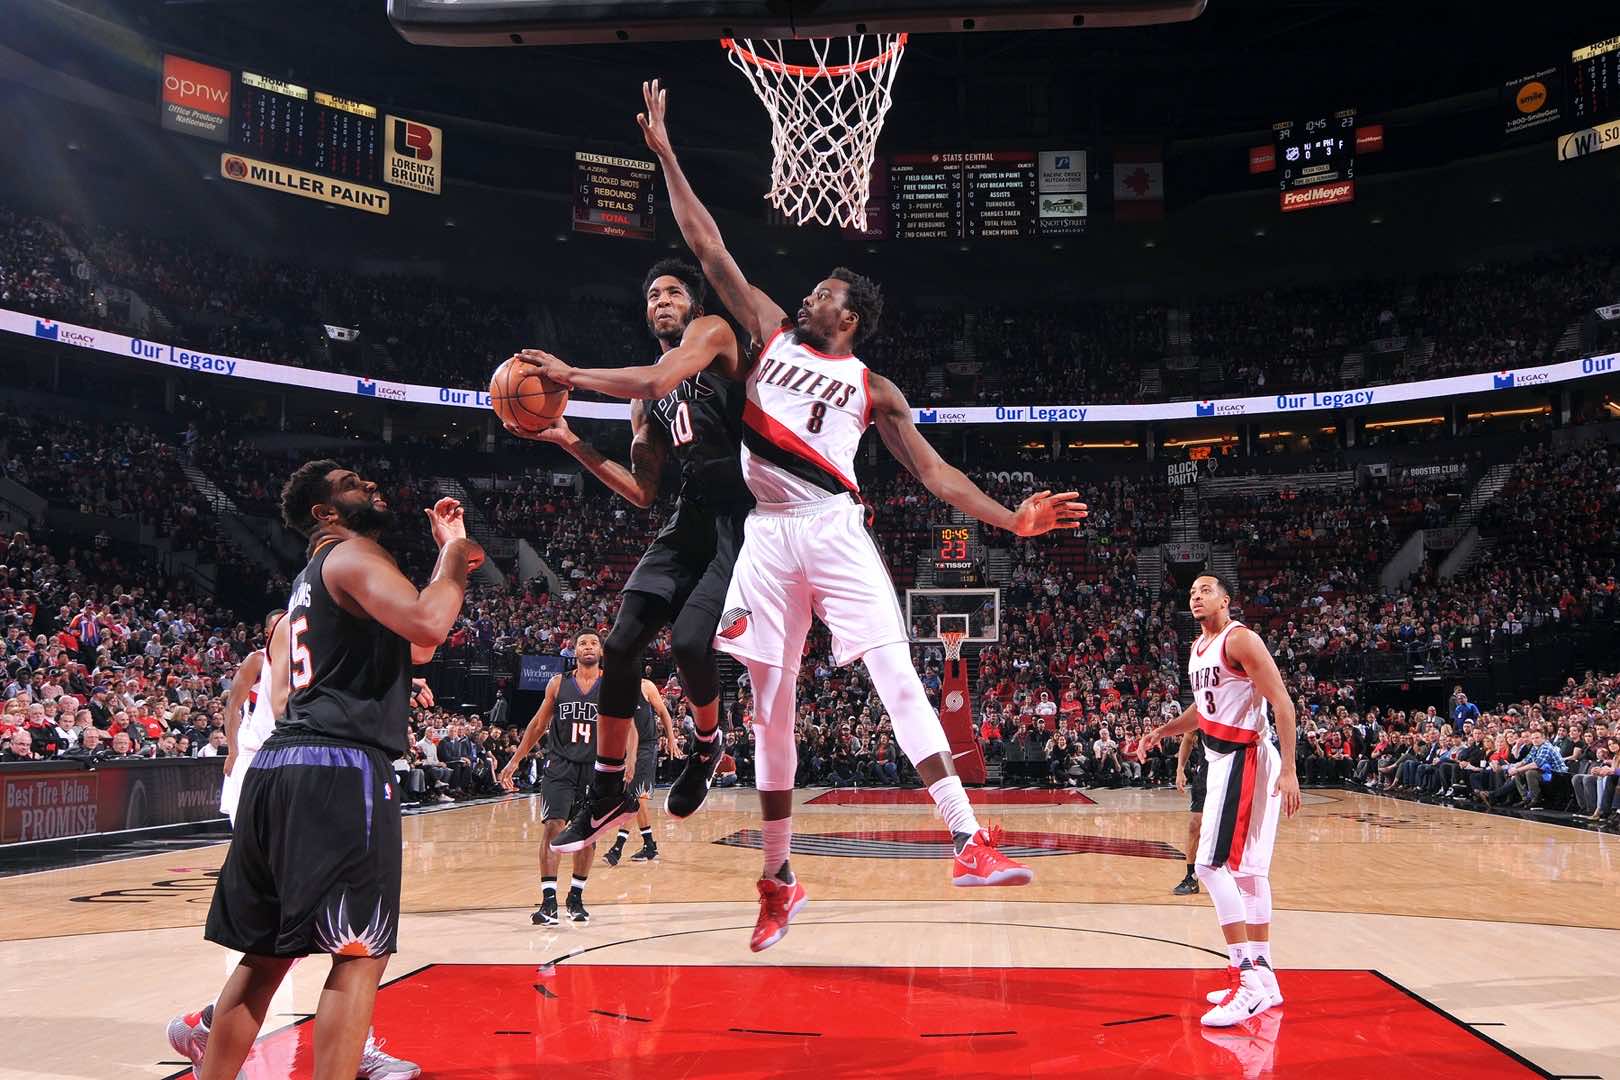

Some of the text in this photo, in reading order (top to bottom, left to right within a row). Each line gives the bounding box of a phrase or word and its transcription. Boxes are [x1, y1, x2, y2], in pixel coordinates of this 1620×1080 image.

[1590, 37, 1617, 51] HOME
[165, 75, 229, 103] opnw
[261, 75, 289, 89] HOME
[168, 104, 224, 125] Office Products
[175, 114, 216, 131] Nationwide
[1342, 117, 1353, 127] 23
[1280, 130, 1290, 140] 39
[1323, 138, 1334, 147] PHI
[1339, 140, 1343, 150] F
[1326, 147, 1331, 155] 3
[391, 157, 435, 174] LORENTZ
[580, 153, 650, 169] HUSTLEBOARD
[965, 153, 994, 161] CENTRAL
[391, 167, 435, 187] BRUUN
[591, 175, 619, 186] BLOCKED
[620, 180, 639, 188] SHOTS
[250, 165, 387, 209] MILLER PAINT
[580, 184, 589, 193] 15
[594, 187, 636, 200] REBOUNDS
[597, 200, 634, 211] STEALS
[648, 206, 653, 214] 3
[601, 212, 631, 224] TOTAL
[61, 330, 236, 376] LEGACY Our Legacy
[1517, 356, 1616, 383] LEGACY Our
[757, 357, 857, 408] BLAZERS
[378, 387, 406, 398] LEGACY
[440, 388, 469, 405] Our
[1217, 389, 1374, 412] LEGACY Our Legacy
[807, 401, 826, 434] 8
[995, 406, 1023, 420] Our
[1029, 405, 1088, 422] Legacy
[1168, 460, 1198, 476] BLOCK
[1410, 464, 1459, 476] BOOSTER CLUB
[1168, 470, 1199, 486] PARTY
[941, 528, 969, 540] 10:45
[941, 540, 967, 560] 23
[1205, 691, 1216, 715] 3
[571, 723, 591, 744] 14
[7, 779, 89, 808] Best Tire Value
[19, 804, 98, 841] PROMISE
